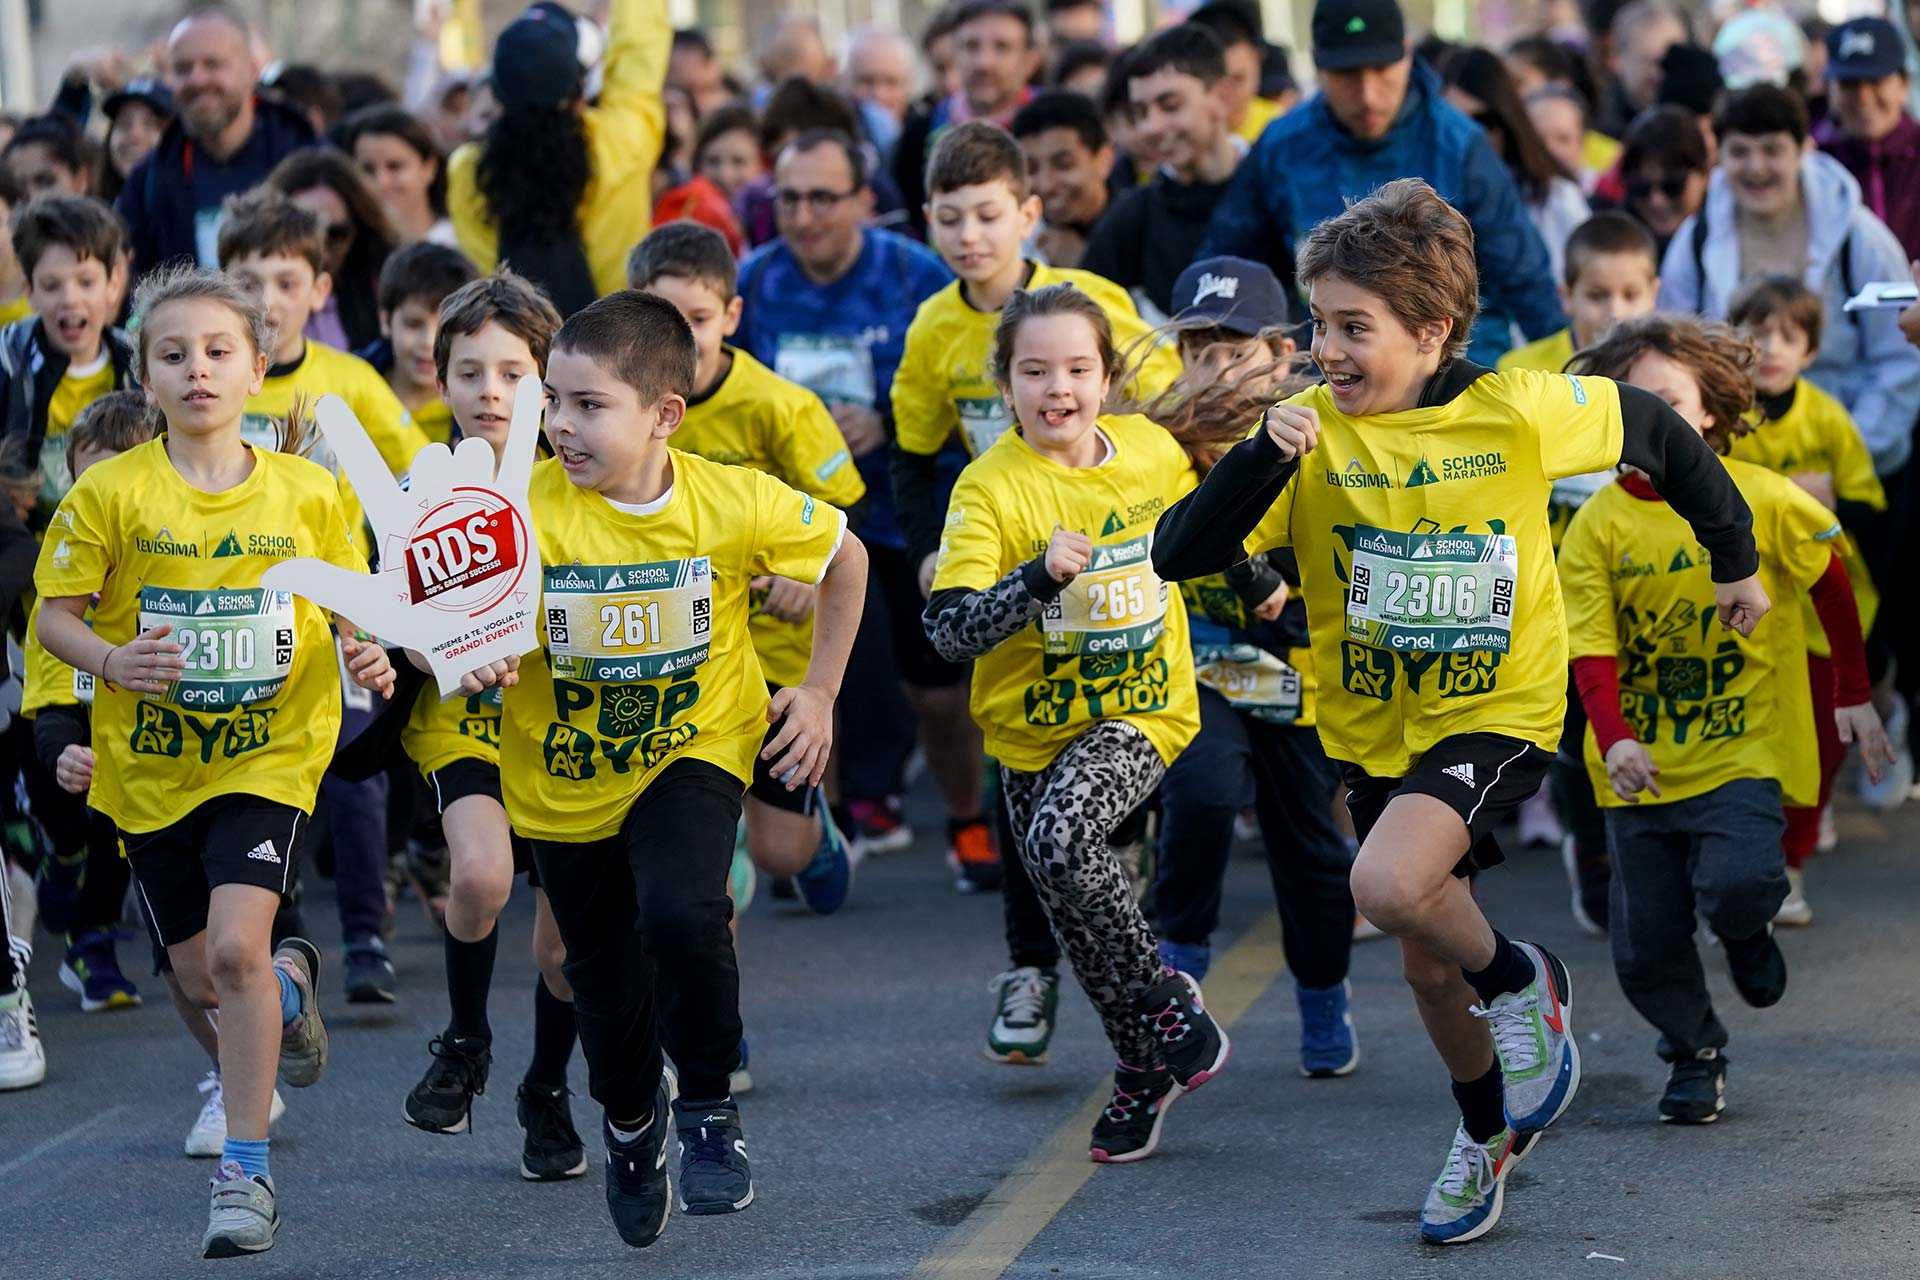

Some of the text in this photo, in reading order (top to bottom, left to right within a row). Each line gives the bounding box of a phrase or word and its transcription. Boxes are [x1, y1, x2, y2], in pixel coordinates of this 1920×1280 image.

[1442, 452, 1506, 471] SCHOOL
[1443, 464, 1507, 481] MARATHON
[248, 534, 297, 549] SCHOOL
[1436, 539, 1476, 550] SCHOOL
[248, 546, 297, 558] MARATHON
[1435, 549, 1477, 557] MARATHON
[424, 559, 502, 597] 100% GRANDI SUCCESSI
[628, 567, 669, 579] SCHOOL
[551, 578, 597, 590] LEVISSIMA
[628, 576, 670, 586] MARATHON
[217, 595, 254, 605] SCHOOL
[1088, 575, 1145, 621] 265
[1384, 571, 1477, 618] 2306
[217, 601, 256, 611] MARATHON
[600, 601, 661, 648] 261
[1351, 617, 1367, 630] 01
[431, 636, 463, 654] INSIEME
[464, 633, 471, 641] A
[484, 615, 515, 632] VOGLIA
[444, 637, 484, 660] GRANDI
[485, 623, 519, 643] EVENTI
[1048, 631, 1065, 642] 01
[1088, 633, 1128, 651] enel
[1350, 632, 1367, 642] 2023
[1391, 633, 1435, 649] enel
[1470, 633, 1507, 644] MILANO
[178, 627, 256, 671] 2310
[1470, 640, 1507, 649] MARATHON
[556, 655, 573, 665] 01
[676, 648, 709, 665] MILANO
[598, 662, 642, 680] enel
[182, 687, 225, 703] enel
[1441, 767, 1476, 789] adidas
[247, 851, 281, 864] adidas
